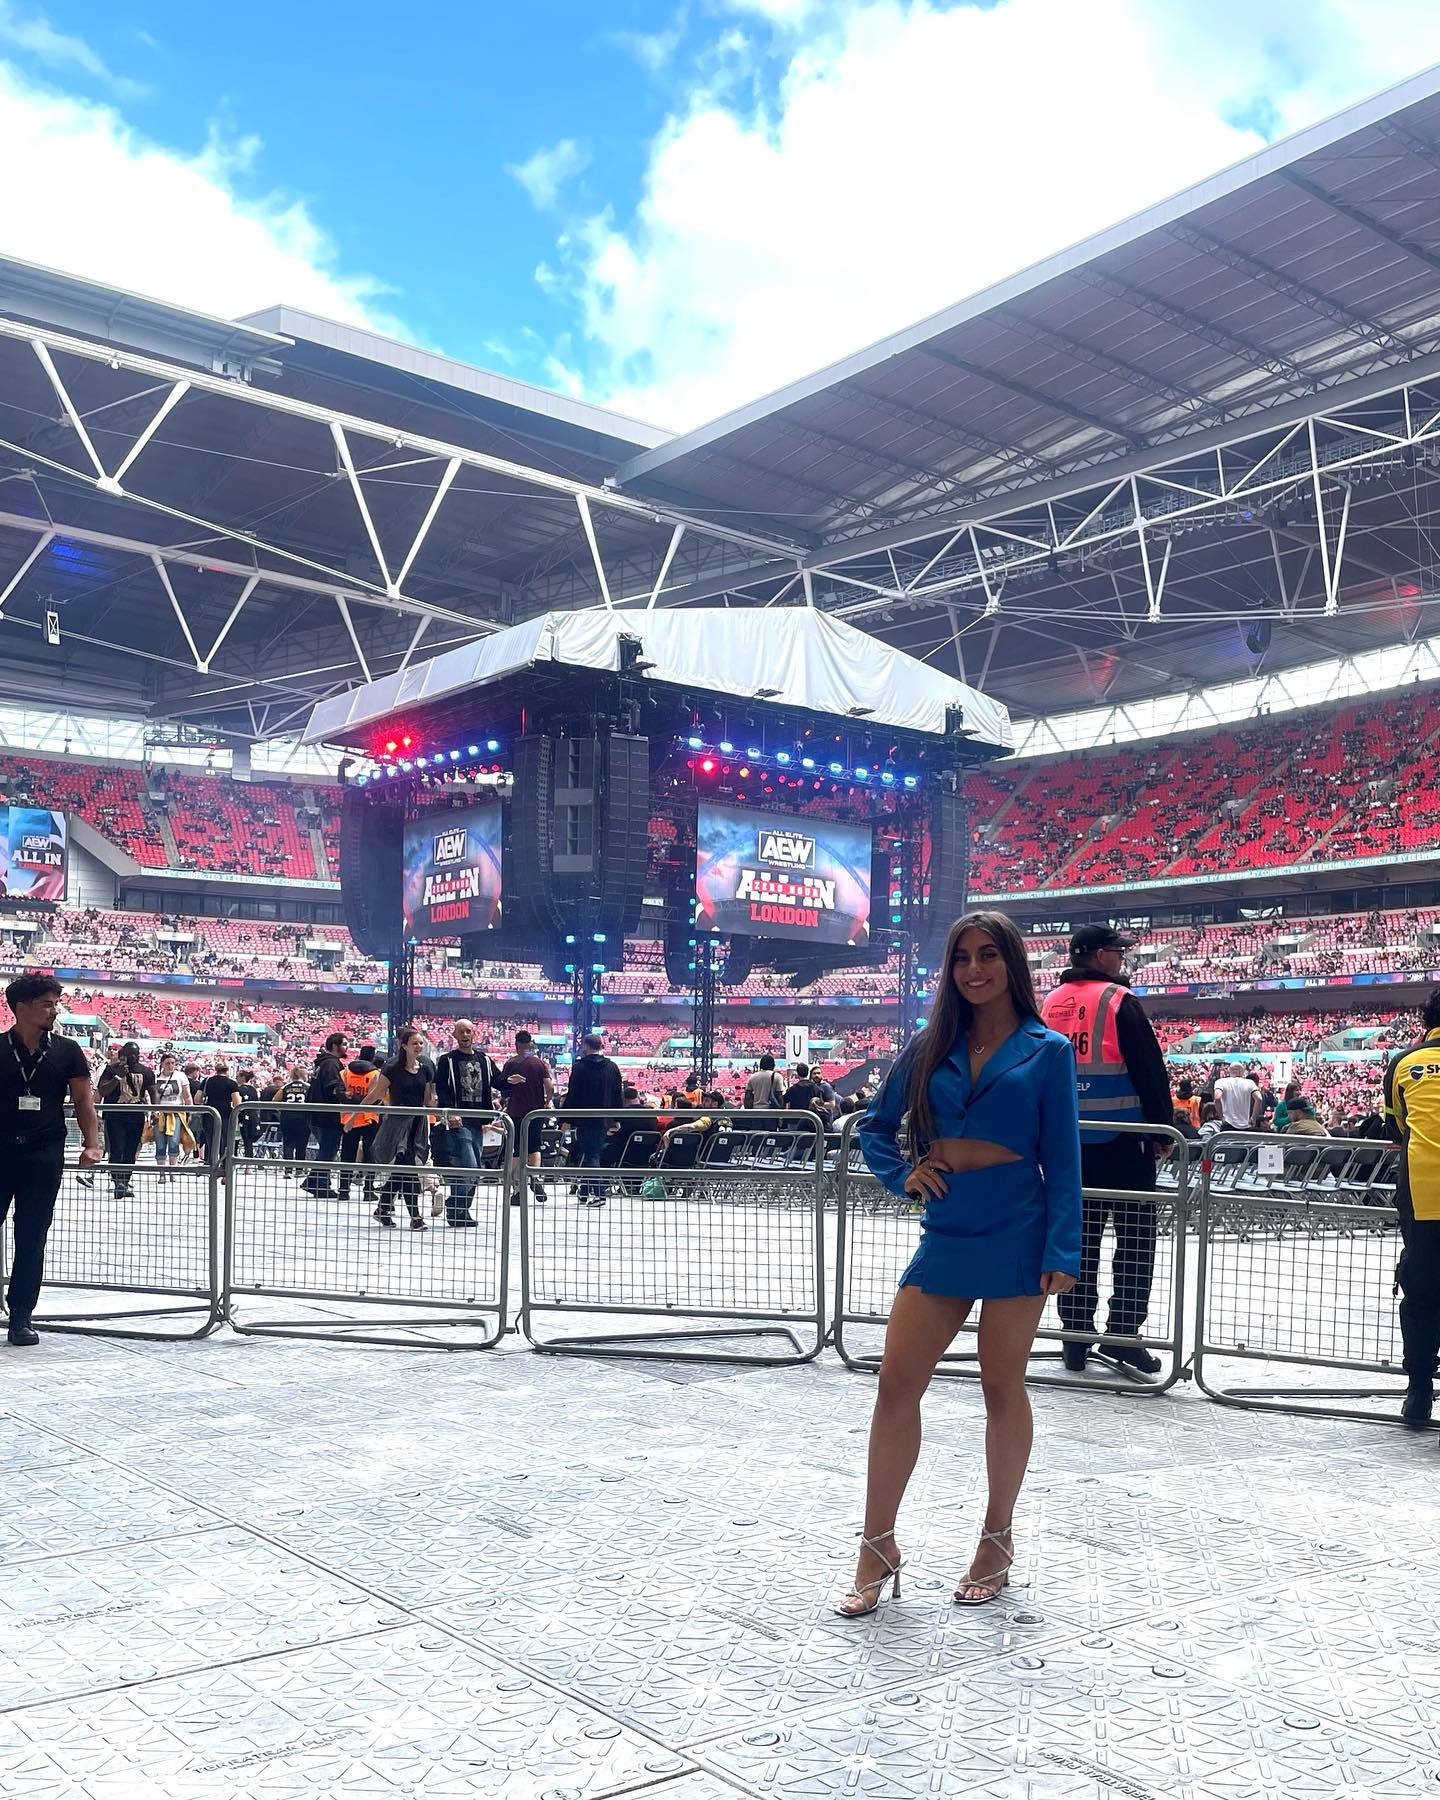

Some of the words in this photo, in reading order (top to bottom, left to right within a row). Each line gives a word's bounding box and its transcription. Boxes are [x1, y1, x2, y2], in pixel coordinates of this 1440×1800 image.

[24, 837, 50, 849] AEW
[437, 833, 465, 861] AEW
[762, 836, 812, 863] AEW
[11, 850, 41, 863] ALL
[45, 853, 61, 865] IN
[769, 860, 805, 869] WRESTLING
[423, 873, 455, 906] ALL
[459, 867, 479, 899] IN
[432, 883, 449, 894] ZERO
[736, 870, 796, 905] ALL
[803, 878, 835, 909] IN
[754, 882, 783, 893] ZERO
[790, 886, 818, 897] HOUR
[431, 901, 469, 923] LONDON
[751, 903, 818, 927] LONDON
[1305, 978, 1317, 987] ALL
[1318, 978, 1326, 986] IN
[1328, 976, 1352, 985] LONDON
[1147, 987, 1158, 995] ALL
[1078, 1006, 1086, 1020] 8
[793, 1035, 801, 1057] U
[1280, 1061, 1286, 1078] T
[1077, 1083, 1090, 1091] ELP
